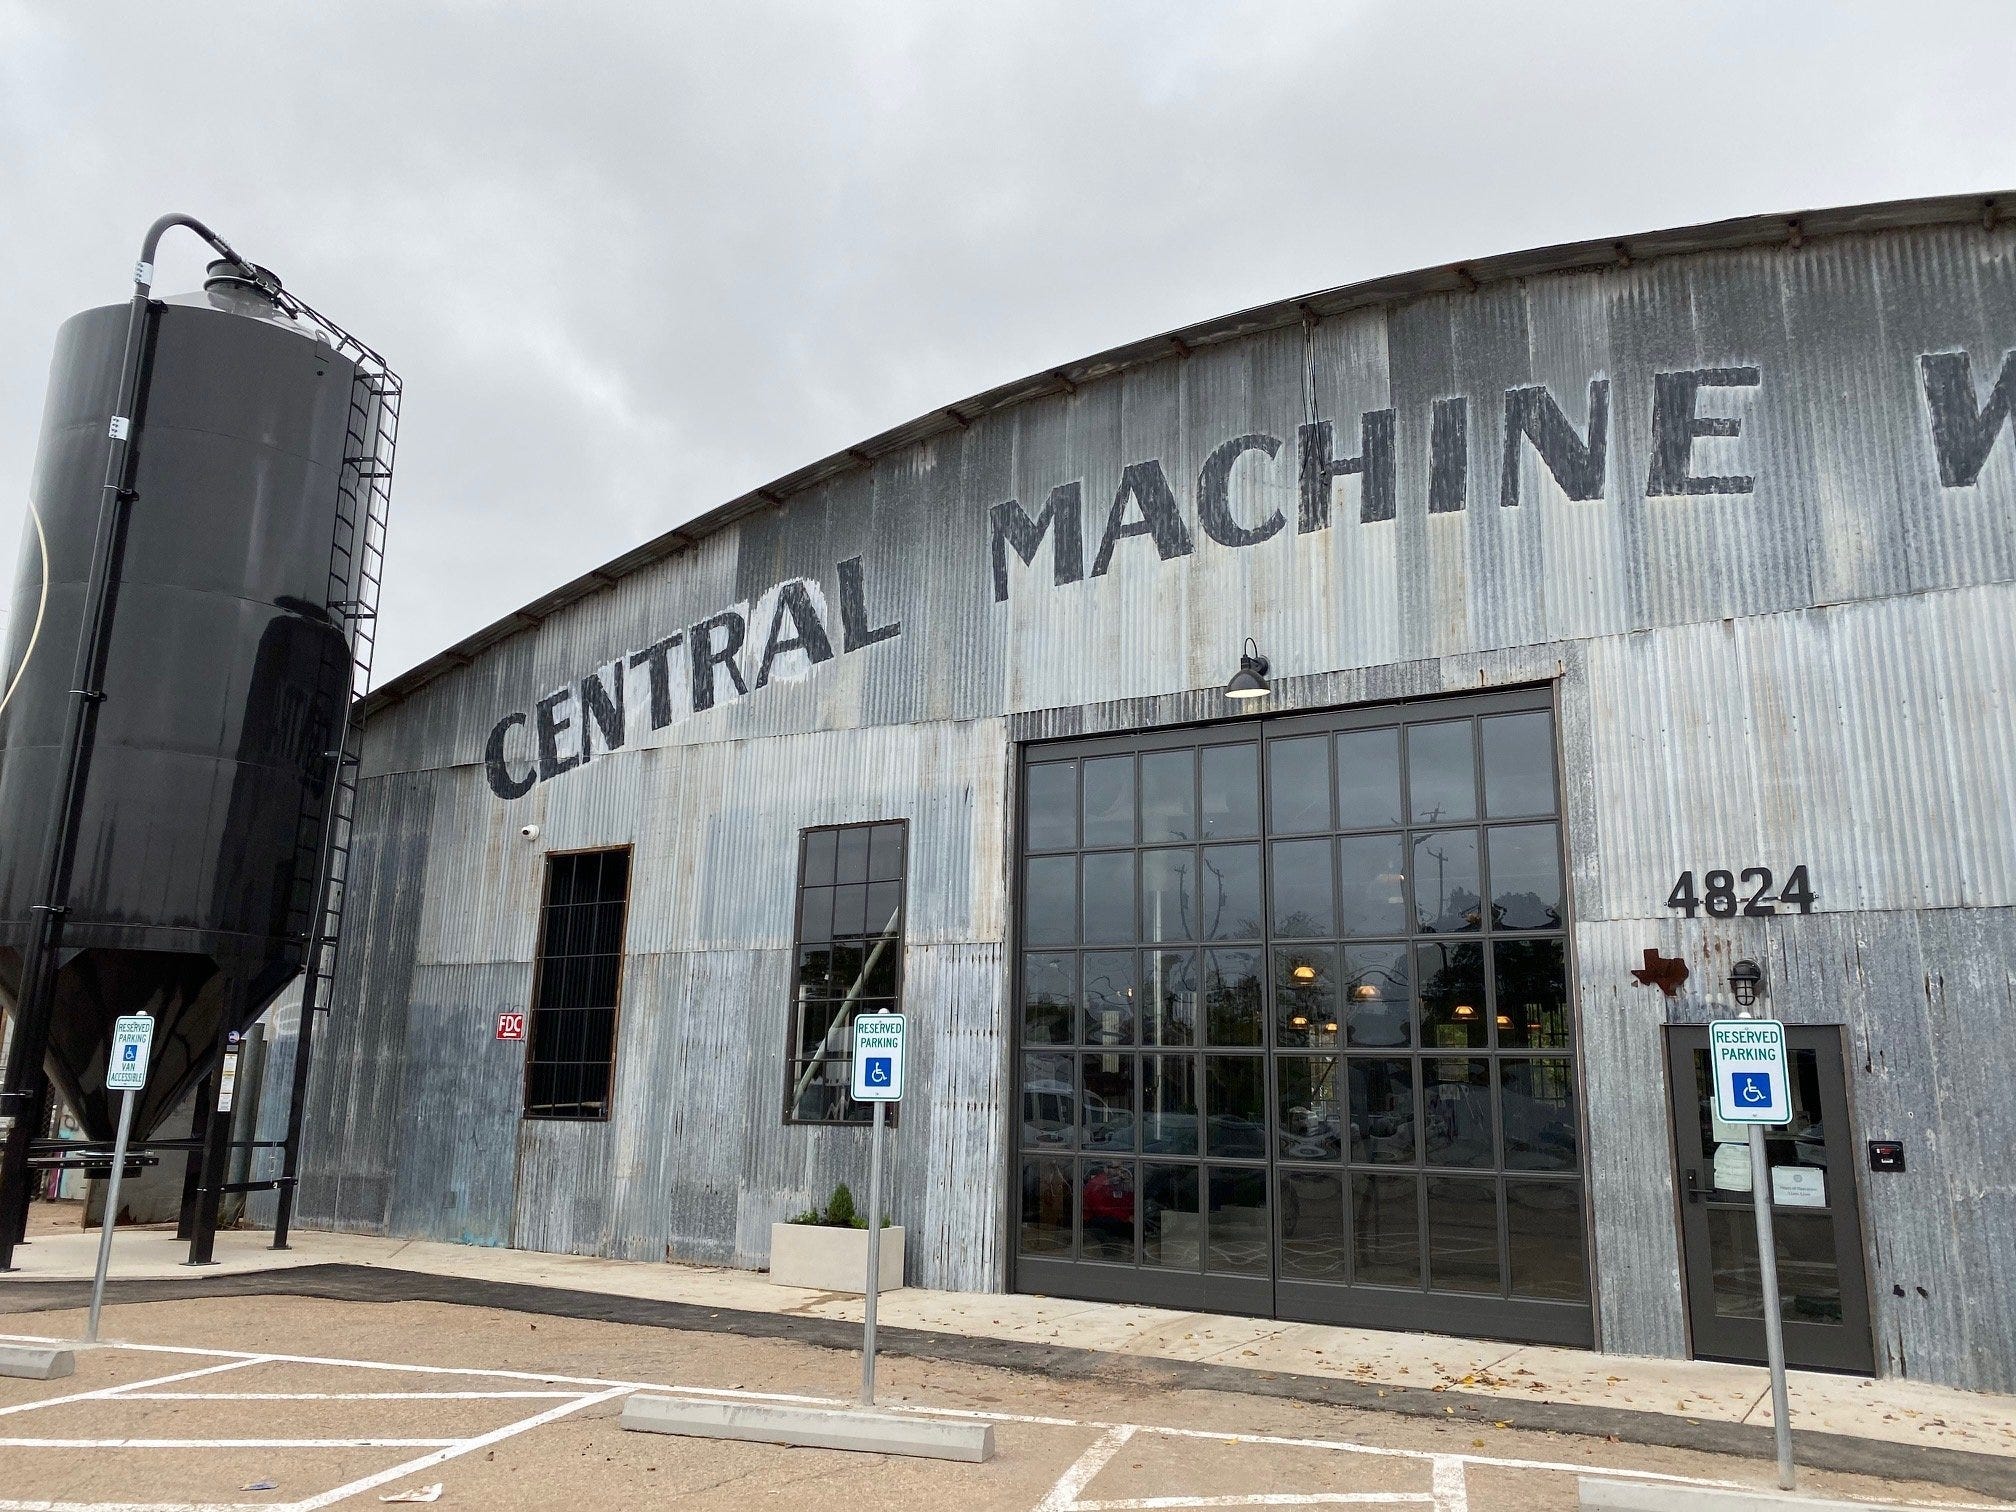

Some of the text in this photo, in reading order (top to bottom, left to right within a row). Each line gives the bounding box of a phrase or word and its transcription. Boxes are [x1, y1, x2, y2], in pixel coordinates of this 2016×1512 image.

[485, 555, 900, 799] CENTRAL
[990, 366, 1760, 602] MACHINE
[1668, 865, 1815, 918] 4824
[118, 1023, 150, 1033] RESERVED
[499, 1015, 522, 1032] FDC
[859, 1023, 901, 1034] RESERVED
[118, 1033, 147, 1043] PARKING
[861, 1037, 898, 1048] PARKING
[1716, 1031, 1778, 1044] RESERVED
[1722, 1048, 1776, 1061] PARKING
[122, 1063, 136, 1072] VAN
[111, 1072, 143, 1083] ACCESSIBLE
